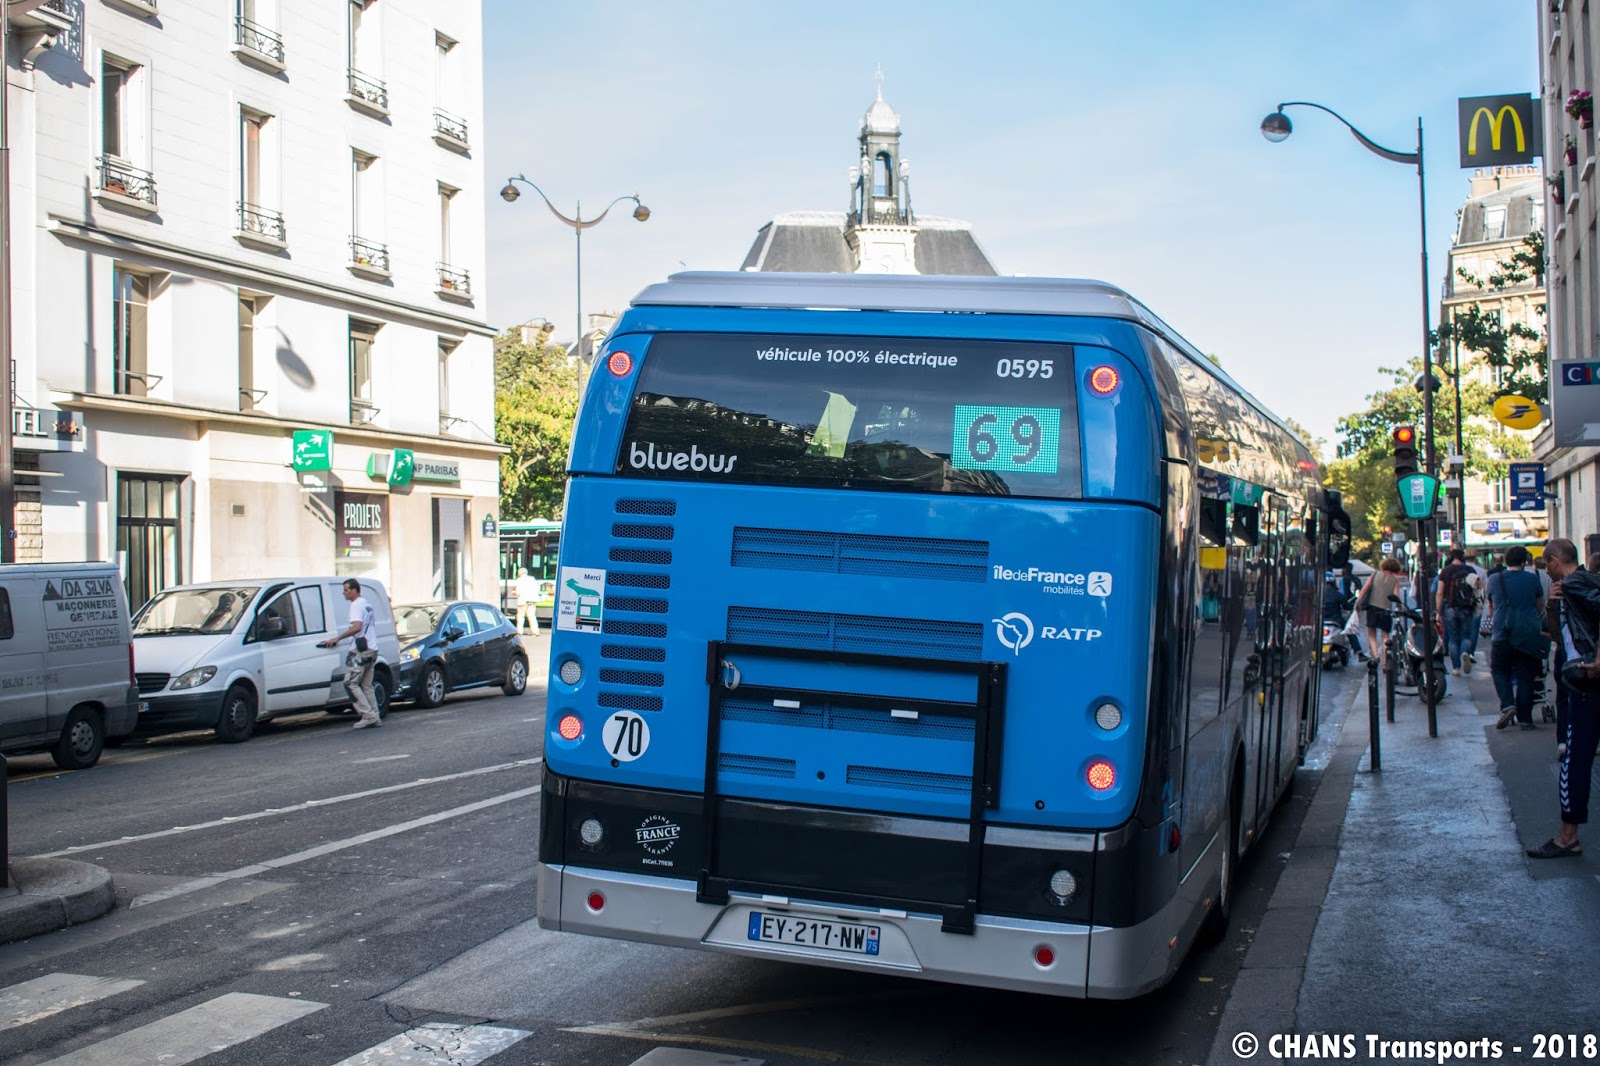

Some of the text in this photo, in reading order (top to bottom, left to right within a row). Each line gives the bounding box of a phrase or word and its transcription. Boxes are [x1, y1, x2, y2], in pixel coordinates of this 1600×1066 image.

[756, 348, 958, 368] véhicule 100% électrique
[996, 358, 1054, 379] 0595
[13, 408, 48, 435] TEL
[967, 411, 1044, 467] 69
[629, 441, 738, 473] bluebus
[424, 464, 459, 477] PARIBAS
[343, 502, 382, 529] PROJETS
[583, 573, 602, 581] Merci
[64, 580, 83, 597] DA
[1042, 584, 1085, 596] mobilités
[56, 599, 117, 612] MAÇONNERIE
[47, 627, 120, 640] RENOVATIONS
[1041, 626, 1103, 641] RATP
[612, 715, 643, 757] 70
[641, 815, 670, 828] ORIGINE
[643, 840, 675, 855] GARANTIE
[762, 917, 865, 950] EY-217-NW
[867, 940, 878, 951] 75
